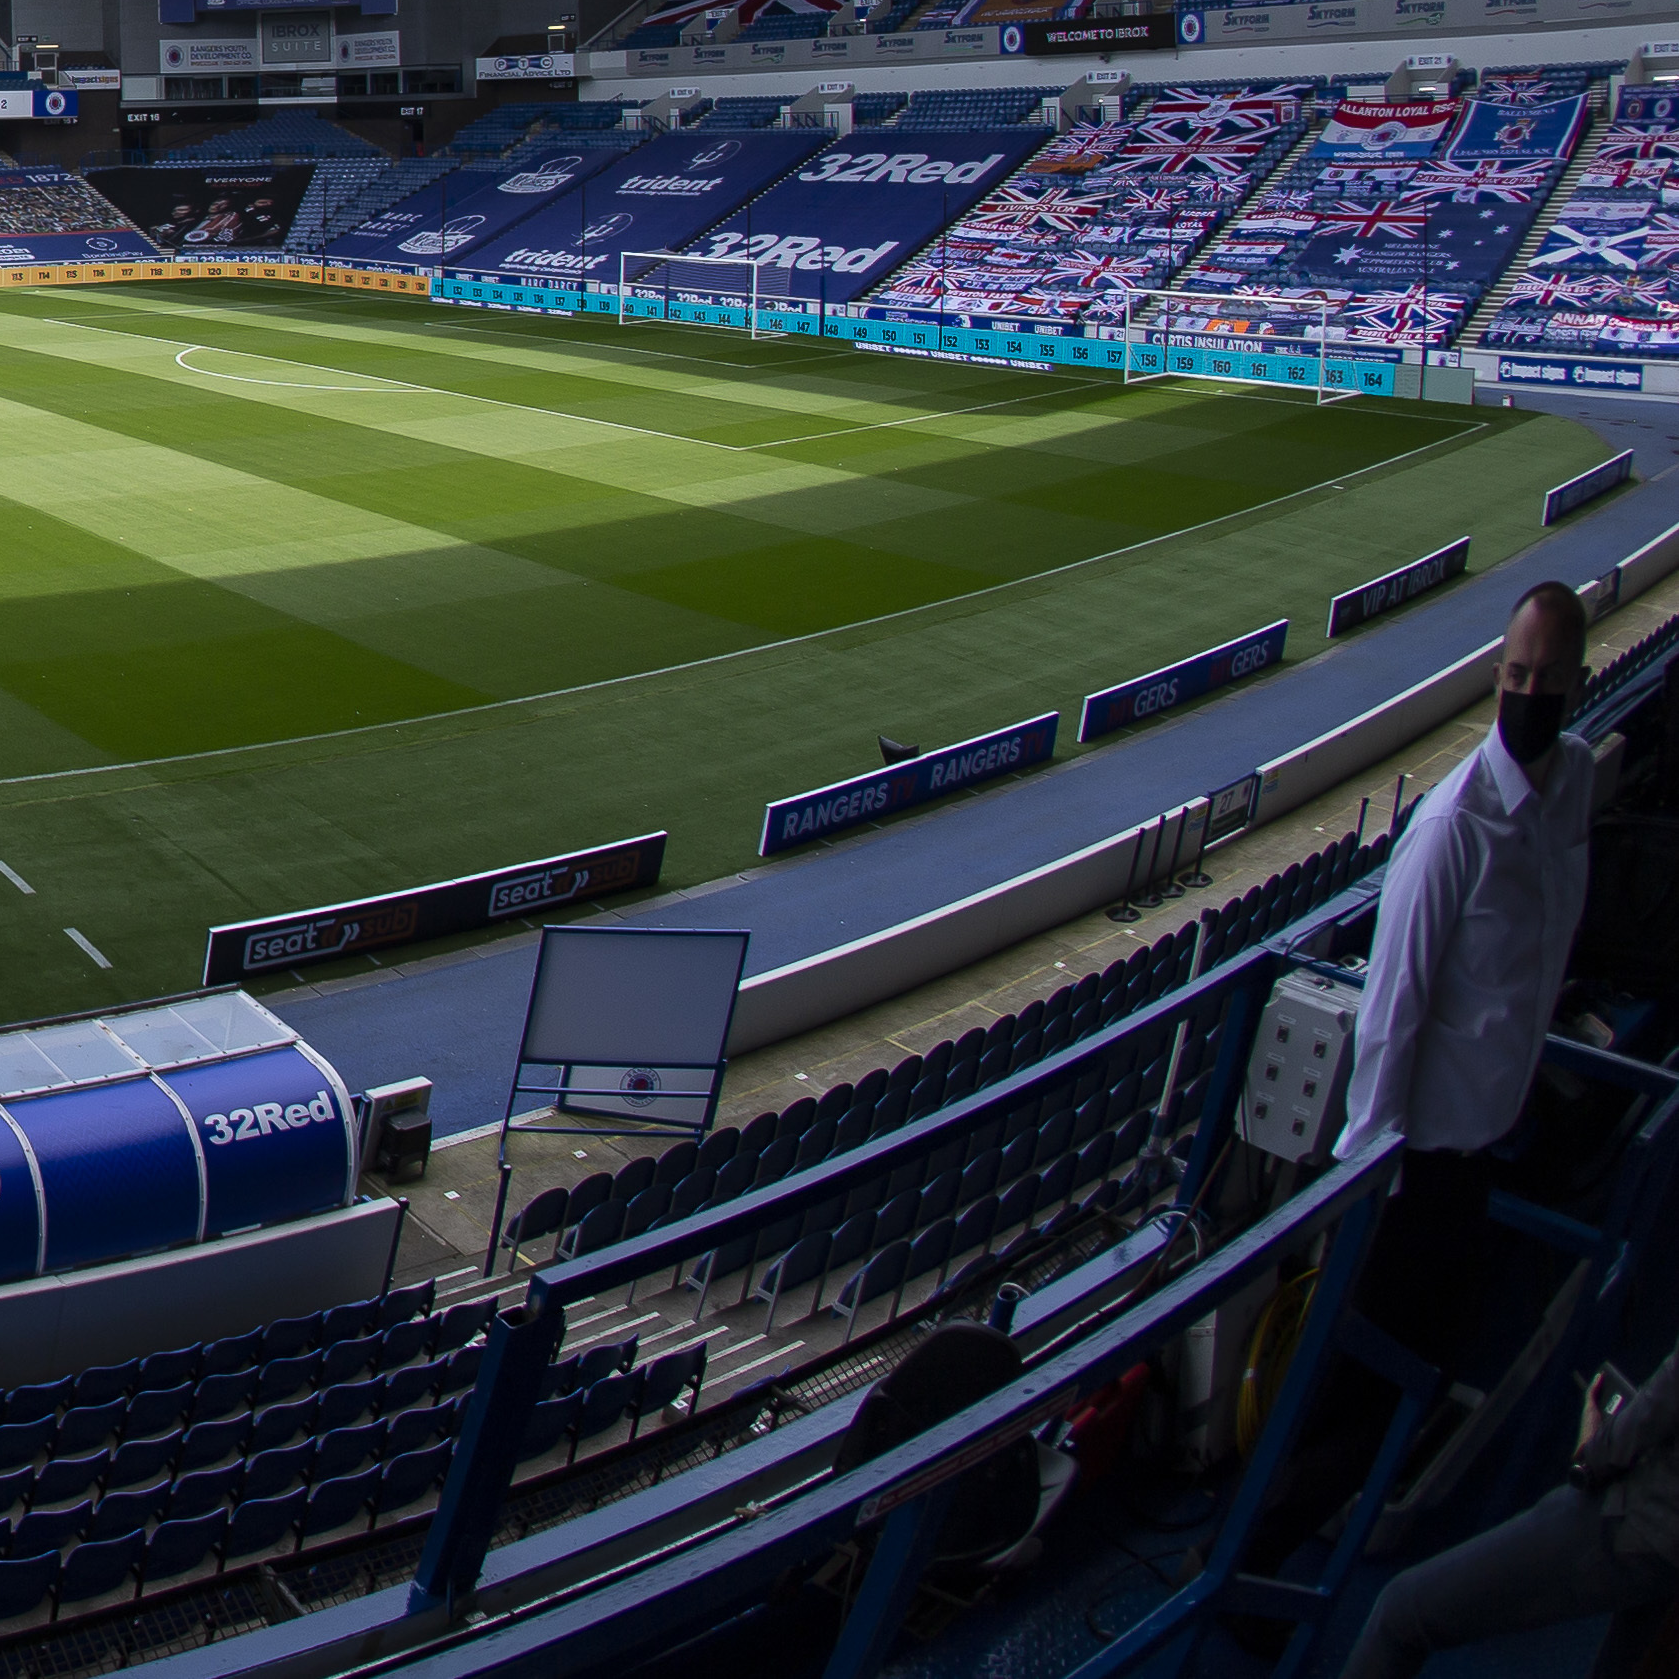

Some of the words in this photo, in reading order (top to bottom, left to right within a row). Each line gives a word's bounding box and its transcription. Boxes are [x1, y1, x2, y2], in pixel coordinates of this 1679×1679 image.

[271, 23, 320, 39] IBROX
[271, 40, 322, 52] SUITE
[25, 172, 74, 184] 1872
[798, 152, 1005, 185] 32Red
[617, 175, 724, 193] trident
[996, 204, 1079, 214] LIVINGSTON
[505, 248, 610, 270] trident
[695, 231, 899, 274] 32Red
[1195, 335, 1263, 353] INSULATION
[1212, 358, 1231, 374] 160
[1286, 365, 1306, 382] 162
[1132, 677, 1179, 717] GERS
[929, 736, 1022, 790] RANGERS
[782, 781, 889, 840] RANGERS
[496, 875, 555, 908] seat
[252, 920, 319, 959] seat
[203, 1090, 337, 1147] 32Red
